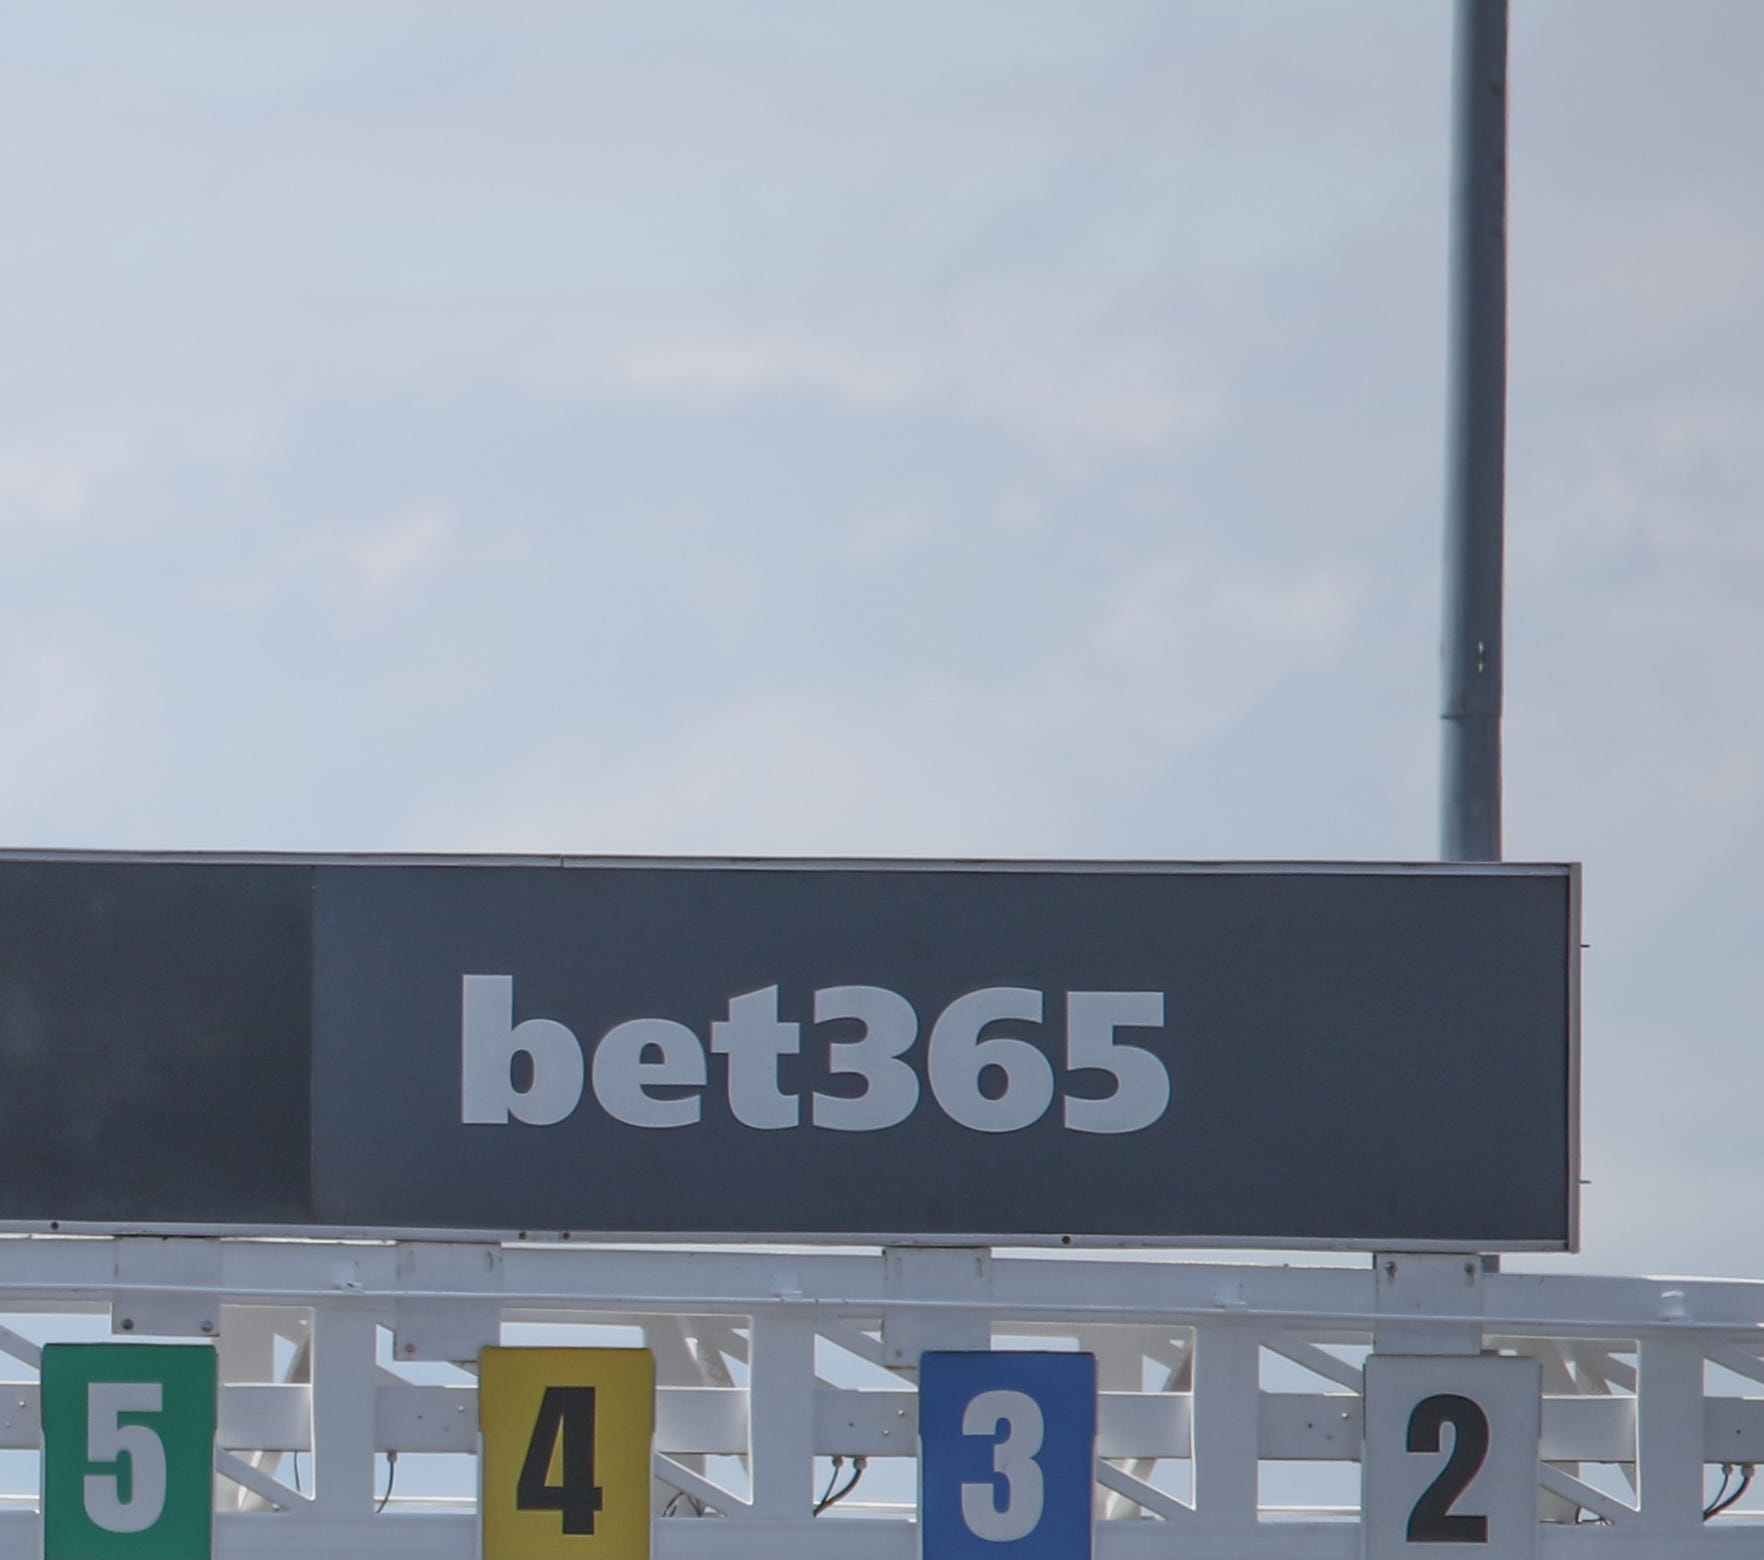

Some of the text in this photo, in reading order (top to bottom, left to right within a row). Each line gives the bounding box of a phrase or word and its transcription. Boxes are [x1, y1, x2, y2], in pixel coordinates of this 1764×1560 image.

[461, 974, 1170, 1133] bet365
[83, 1381, 166, 1533] 5
[516, 1385, 603, 1536] 4
[960, 1389, 1044, 1541] 3
[1405, 1393, 1490, 1544] 2
